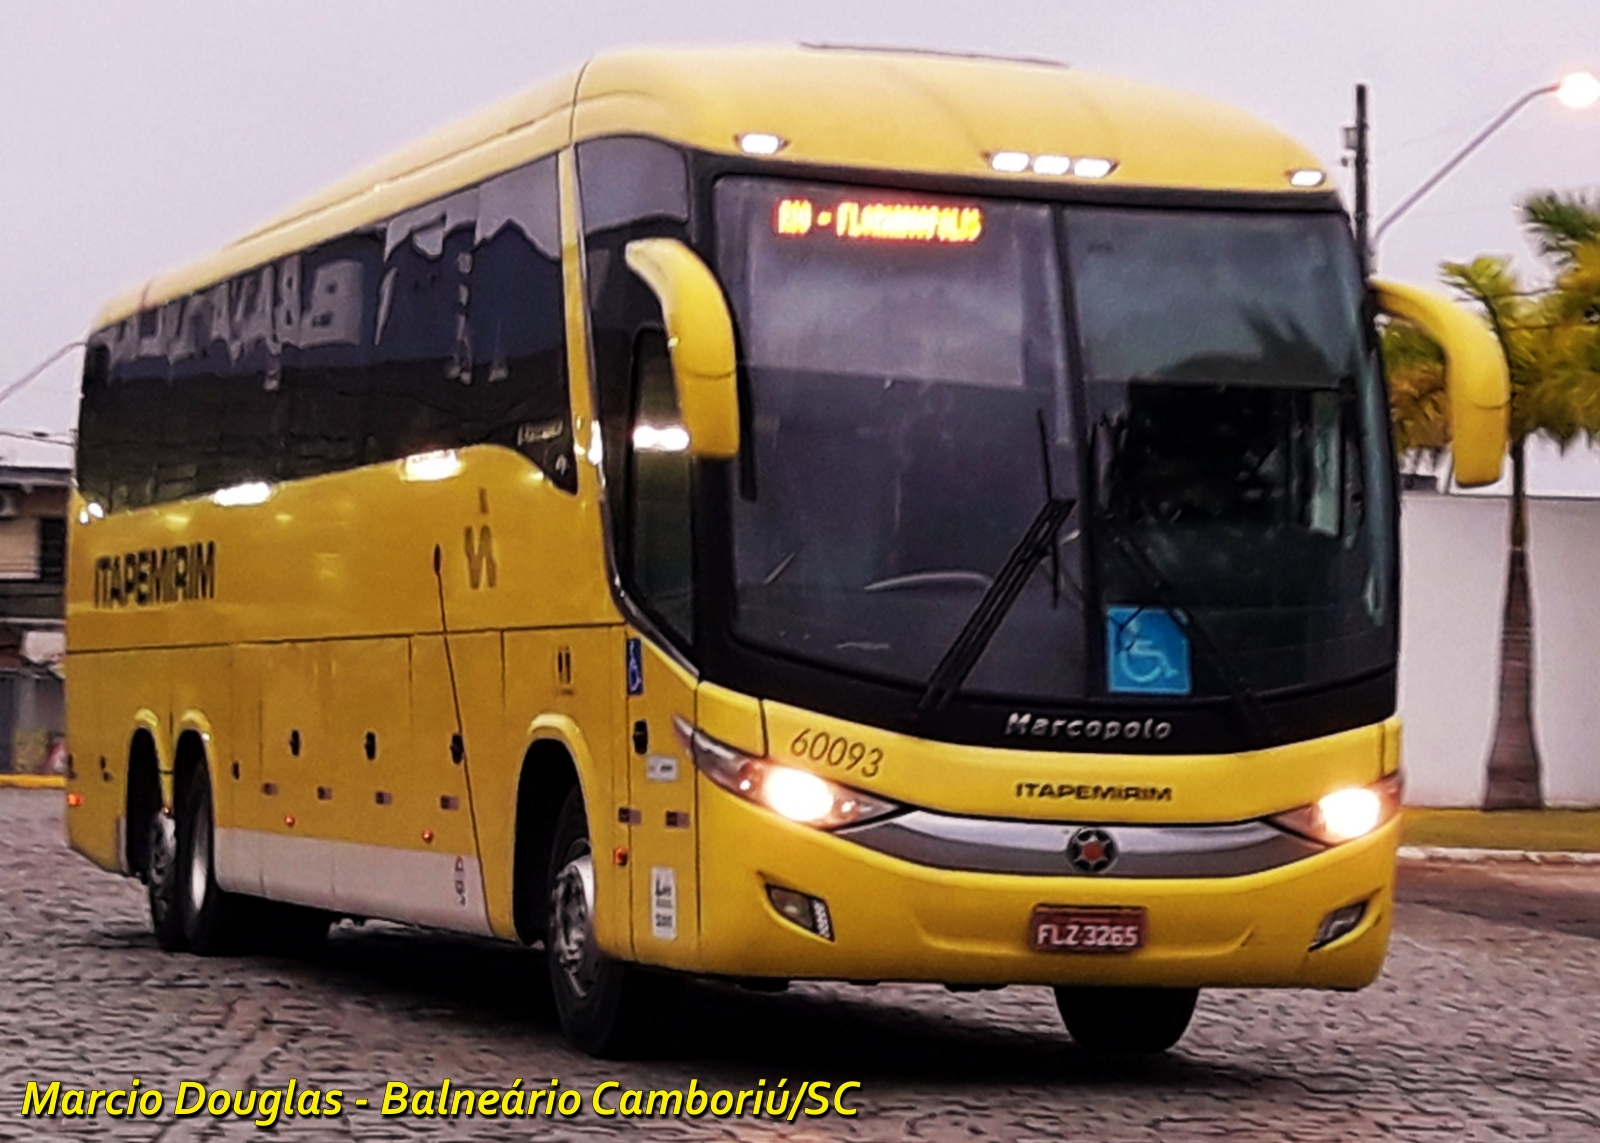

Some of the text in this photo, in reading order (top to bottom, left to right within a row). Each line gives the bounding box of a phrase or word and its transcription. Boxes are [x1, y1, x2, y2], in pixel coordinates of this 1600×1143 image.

[94, 540, 216, 609] ITAPEMIRIM
[1004, 712, 1173, 741] Marcopolo
[790, 727, 884, 779] 60093
[1015, 782, 1174, 802] ITAPEMIRIM
